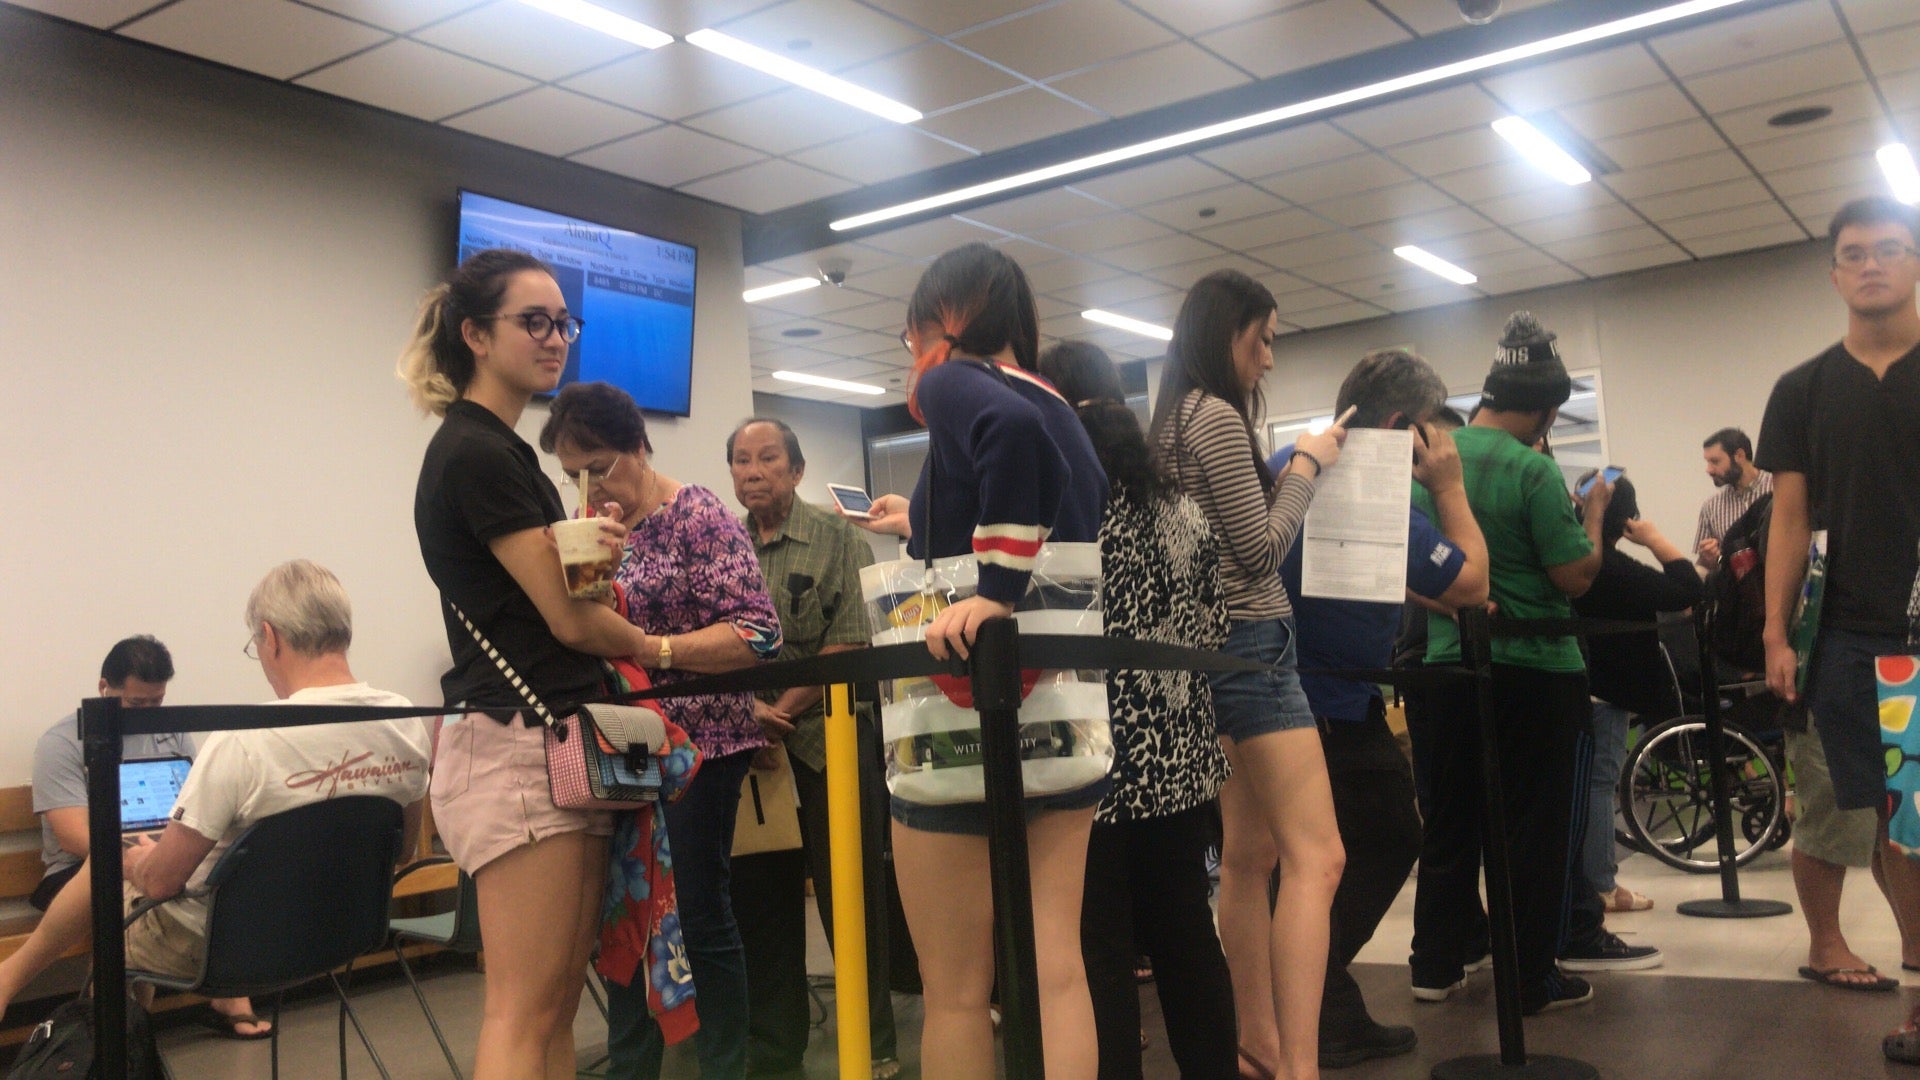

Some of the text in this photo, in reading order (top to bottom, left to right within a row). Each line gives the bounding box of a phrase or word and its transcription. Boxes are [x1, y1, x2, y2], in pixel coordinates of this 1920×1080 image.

[565, 221, 612, 250] AlohaQ
[953, 741, 983, 756] WITT
[284, 749, 420, 800] Hawaiian
